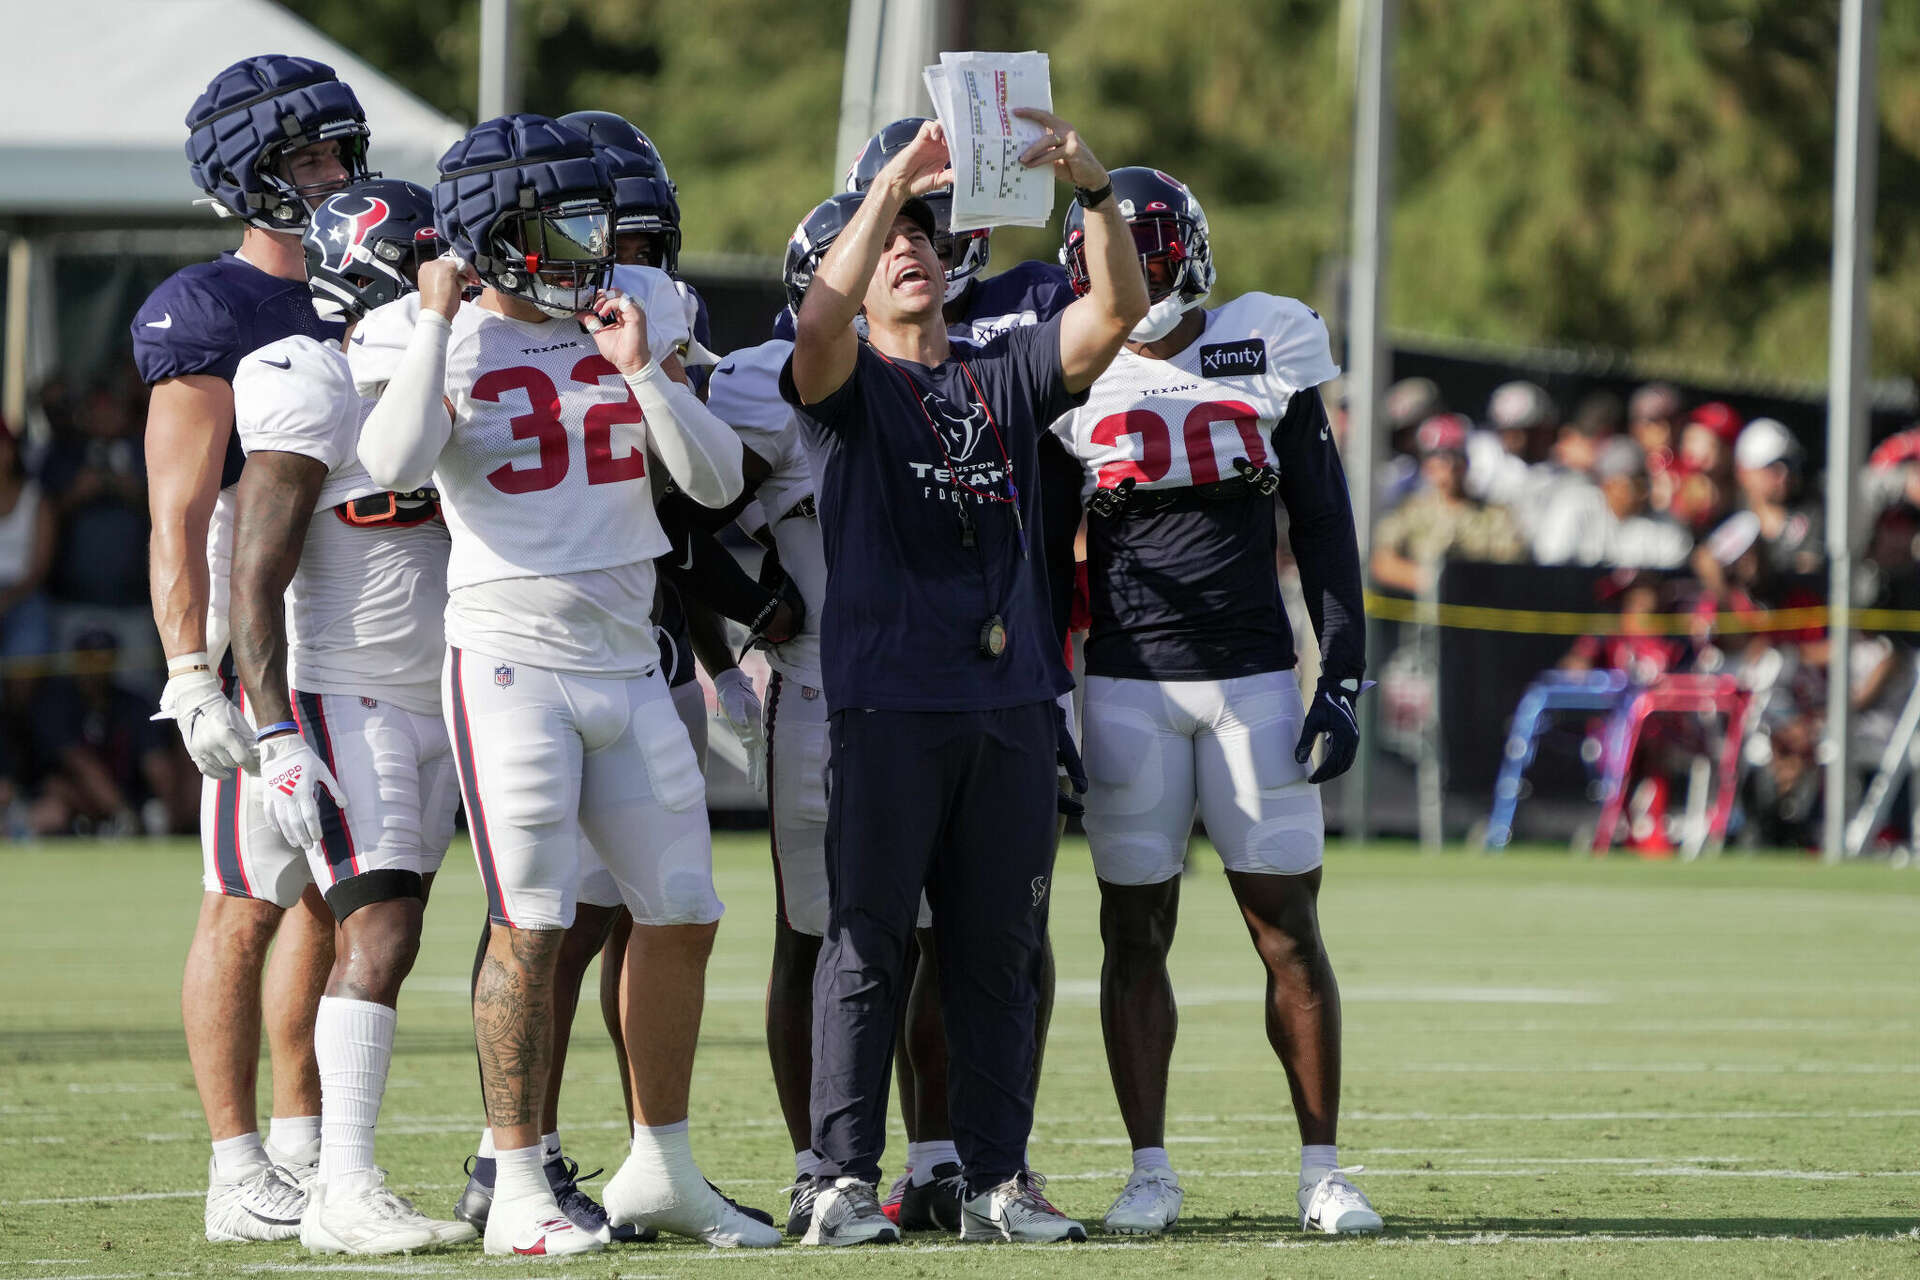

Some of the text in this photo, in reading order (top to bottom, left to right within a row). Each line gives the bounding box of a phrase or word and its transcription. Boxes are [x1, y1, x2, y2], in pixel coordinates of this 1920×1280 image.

[520, 341, 578, 355] TEXANS
[1204, 347, 1264, 370] xfinity
[1140, 384, 1199, 396] TEXANS
[470, 354, 646, 495] 32
[943, 461, 995, 473] USTON
[268, 764, 303, 787] adidas
